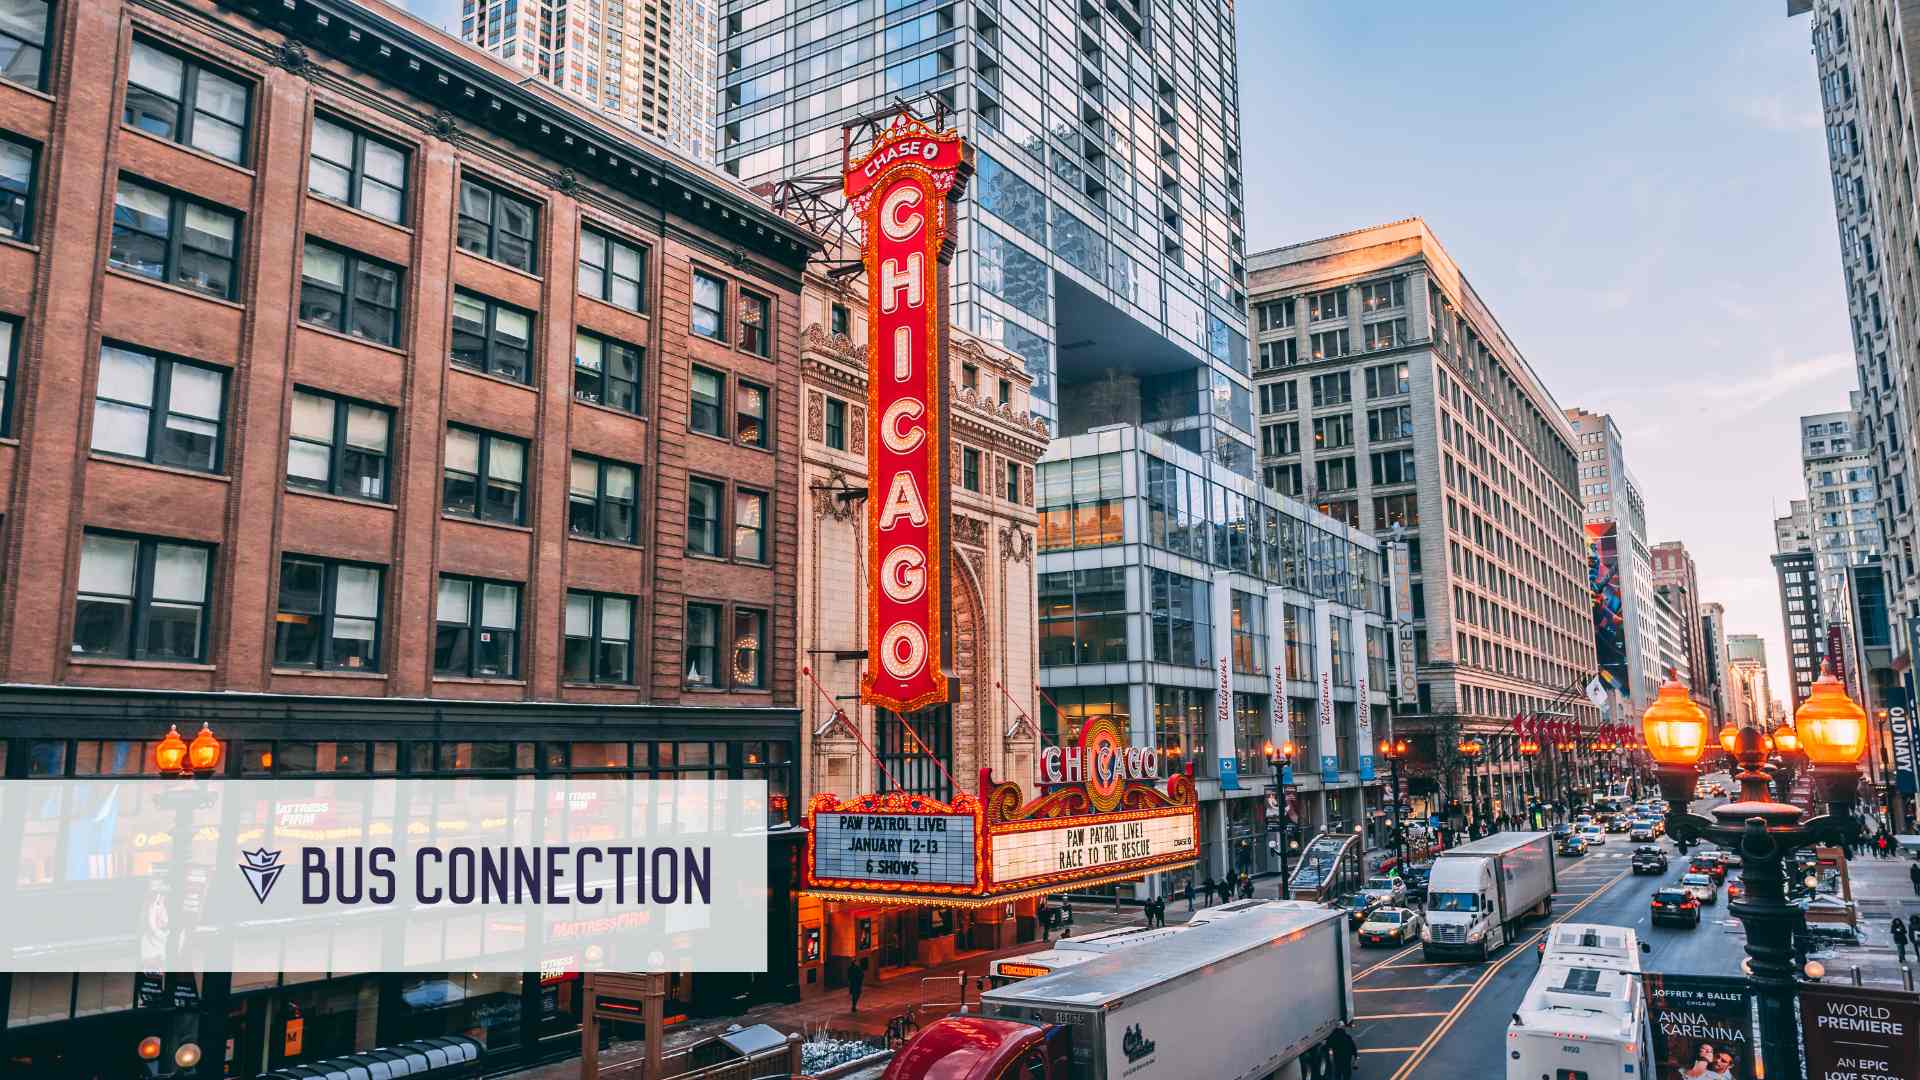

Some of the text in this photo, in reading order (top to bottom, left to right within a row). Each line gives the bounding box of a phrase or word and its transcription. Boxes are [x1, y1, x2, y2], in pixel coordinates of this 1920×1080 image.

[864, 141, 921, 178] CHASE
[880, 186, 928, 680] CHICAGO
[1400, 618, 1416, 702] JOFFREY
[1218, 655, 1231, 721] Walgreens
[1273, 665, 1286, 728] Walgreens
[1890, 706, 1913, 773] OLD NAVY
[1043, 746, 1158, 783] CHICAGO
[840, 815, 947, 832] PAW PATROL LIVE!
[1067, 822, 1144, 848] PAW PATROL LIVE!
[848, 837, 938, 854] JANUARY 12-13
[1059, 839, 1151, 870] RACE TO THE RESCUE
[866, 859, 919, 875] 6 SHOWS
[1653, 989, 1743, 1001] JOFFREY BALLET
[1659, 1011, 1708, 1026] ANNA
[1826, 1002, 1890, 1020] WORLD
[1660, 1023, 1746, 1042] KARENINA
[1817, 1016, 1904, 1036] PREMIERE
[1837, 1057, 1889, 1072] AN EPIC
[1825, 1072, 1857, 1080] LOVE
